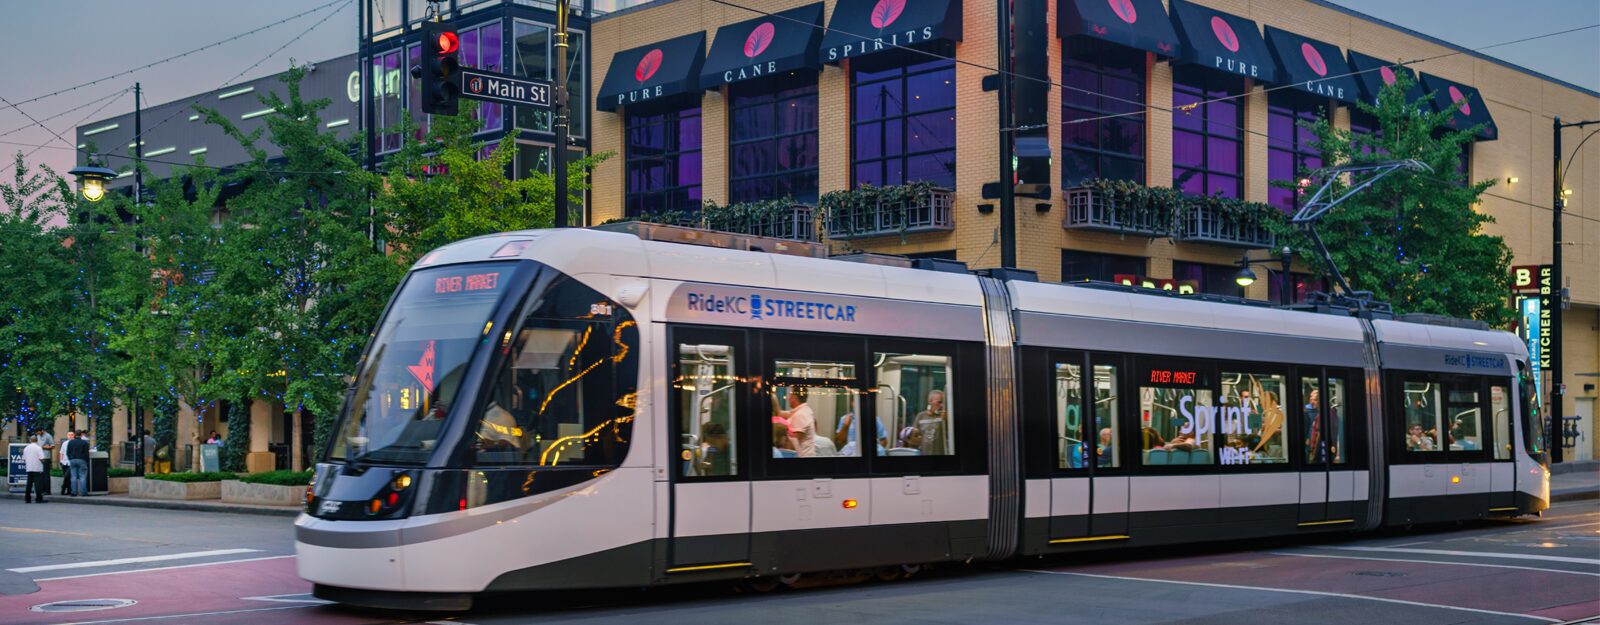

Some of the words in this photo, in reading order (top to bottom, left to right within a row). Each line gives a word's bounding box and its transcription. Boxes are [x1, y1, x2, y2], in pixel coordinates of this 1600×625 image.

[828, 26, 933, 60] SPIRITS
[724, 61, 777, 83] CANE
[1215, 56, 1258, 78] PURE
[487, 79, 525, 99] Main
[530, 86, 546, 103] St
[617, 85, 663, 106] PURE
[1306, 80, 1344, 100] CANE
[434, 276, 463, 294] RIVER
[464, 272, 499, 291] MARKET
[1540, 267, 1551, 295] BAR
[687, 293, 747, 314] RideKC
[765, 299, 856, 322] STREETCAR
[1540, 309, 1551, 368] KITCHEN
[1151, 369, 1171, 383] RIVER
[1173, 371, 1197, 385] MARKET
[1178, 394, 1253, 446] Sprint
